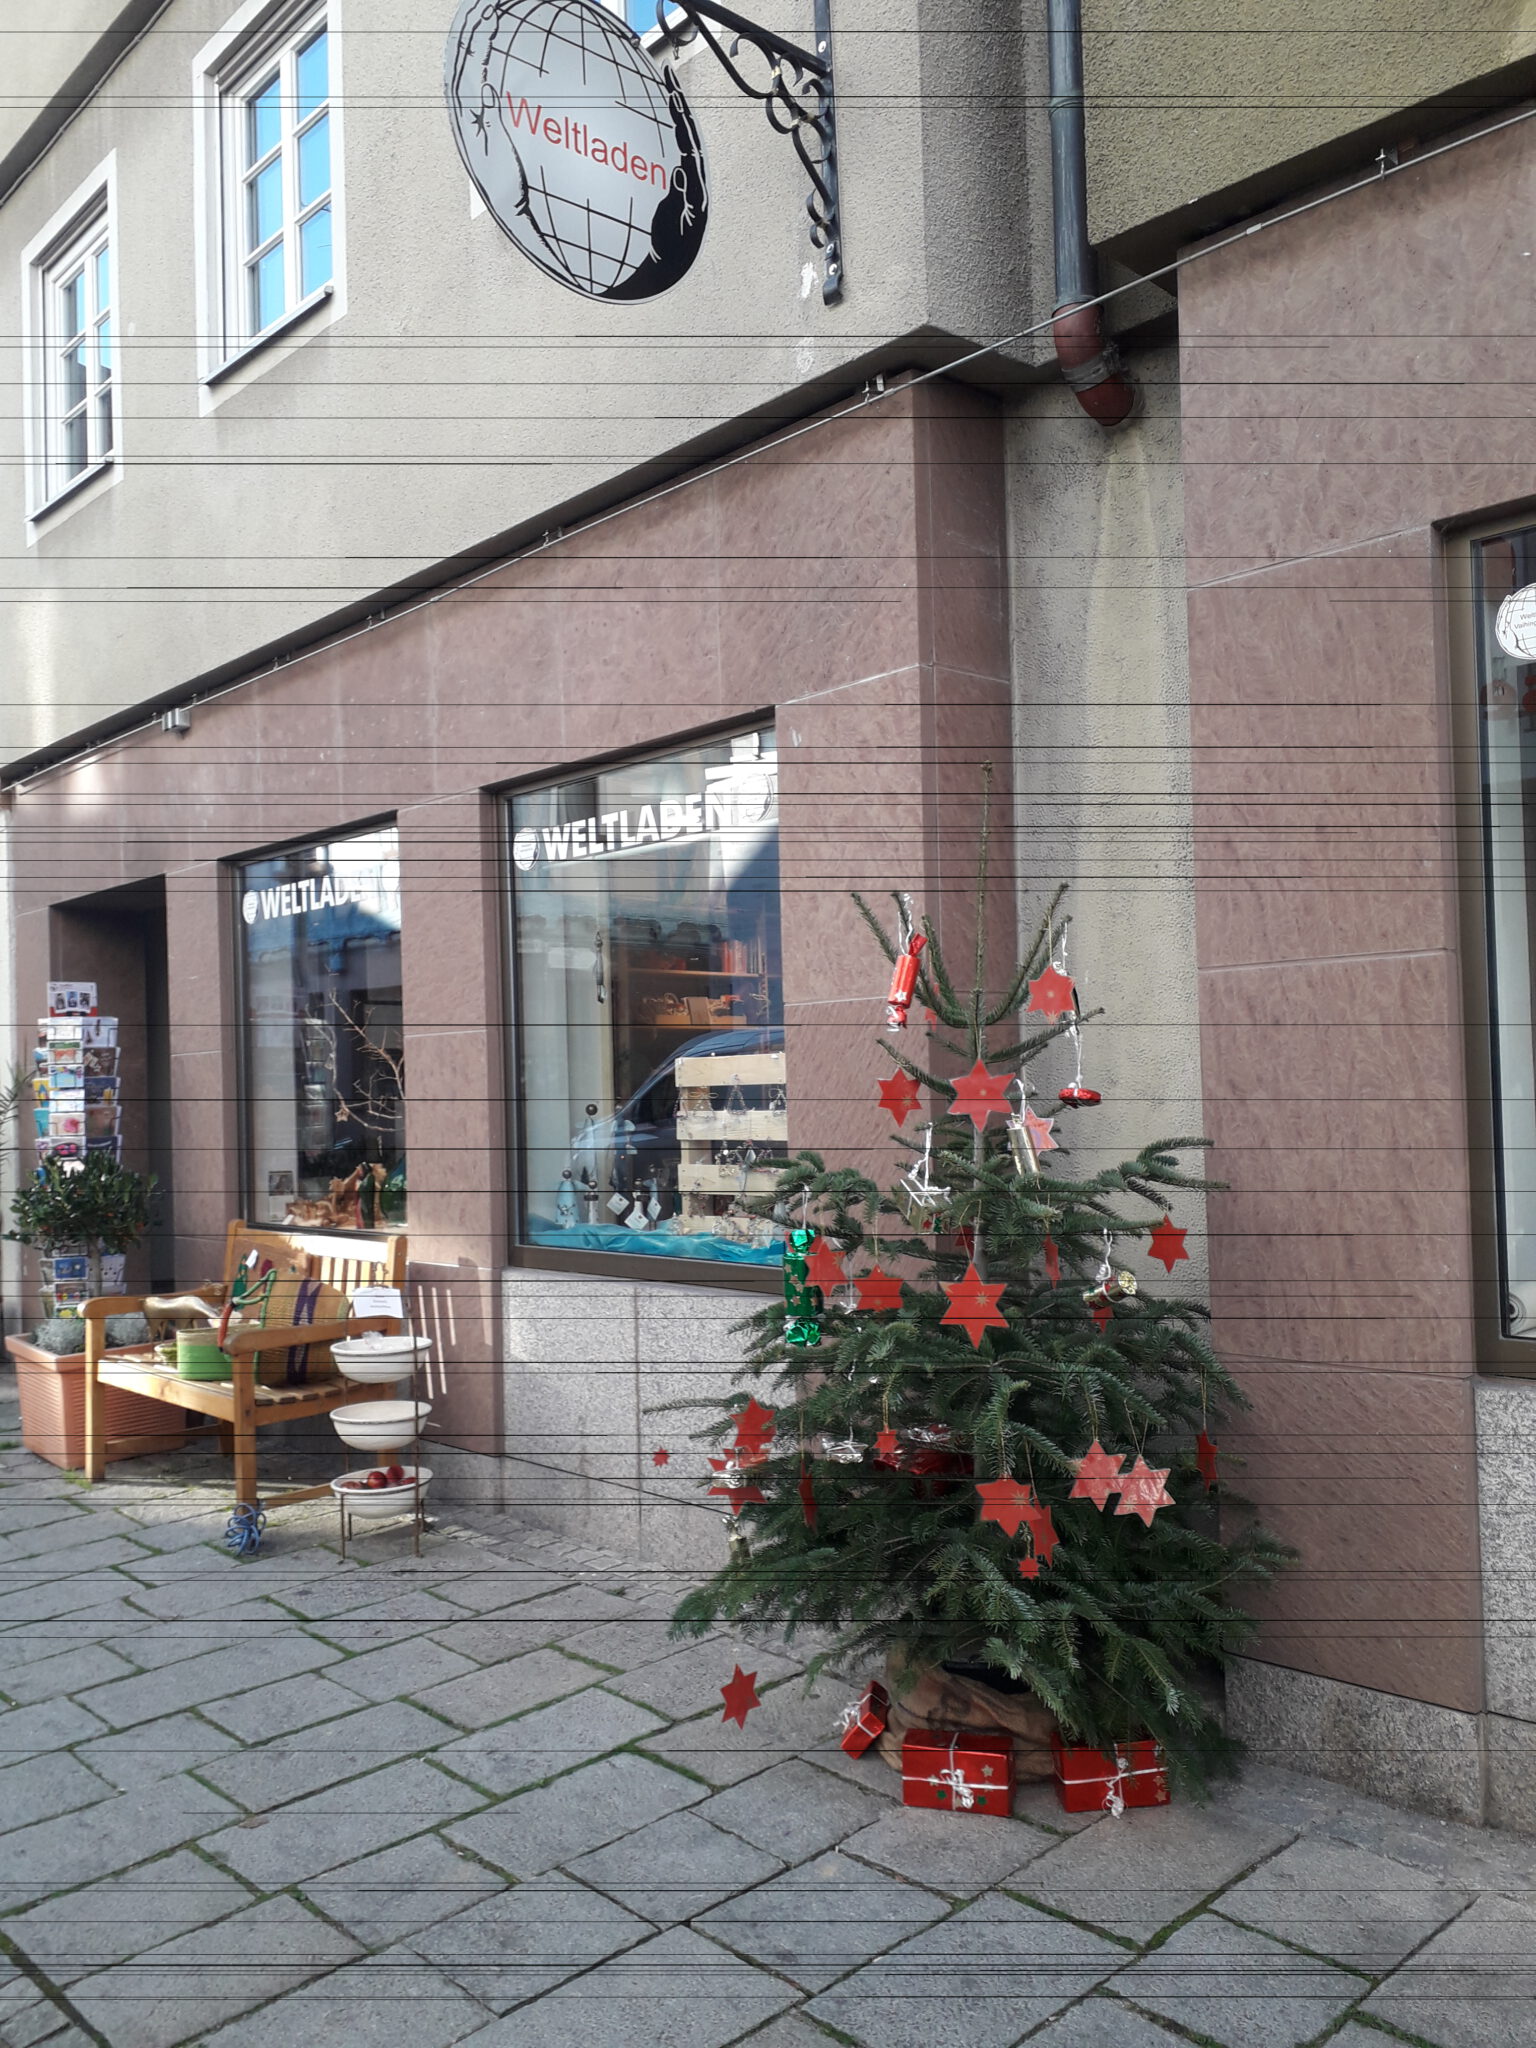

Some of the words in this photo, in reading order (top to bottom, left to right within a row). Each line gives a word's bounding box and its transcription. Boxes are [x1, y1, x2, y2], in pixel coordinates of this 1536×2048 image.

[506, 91, 667, 190] Weltladen
[542, 787, 733, 862] WELTLADEN
[260, 867, 378, 920] WELTLADE
